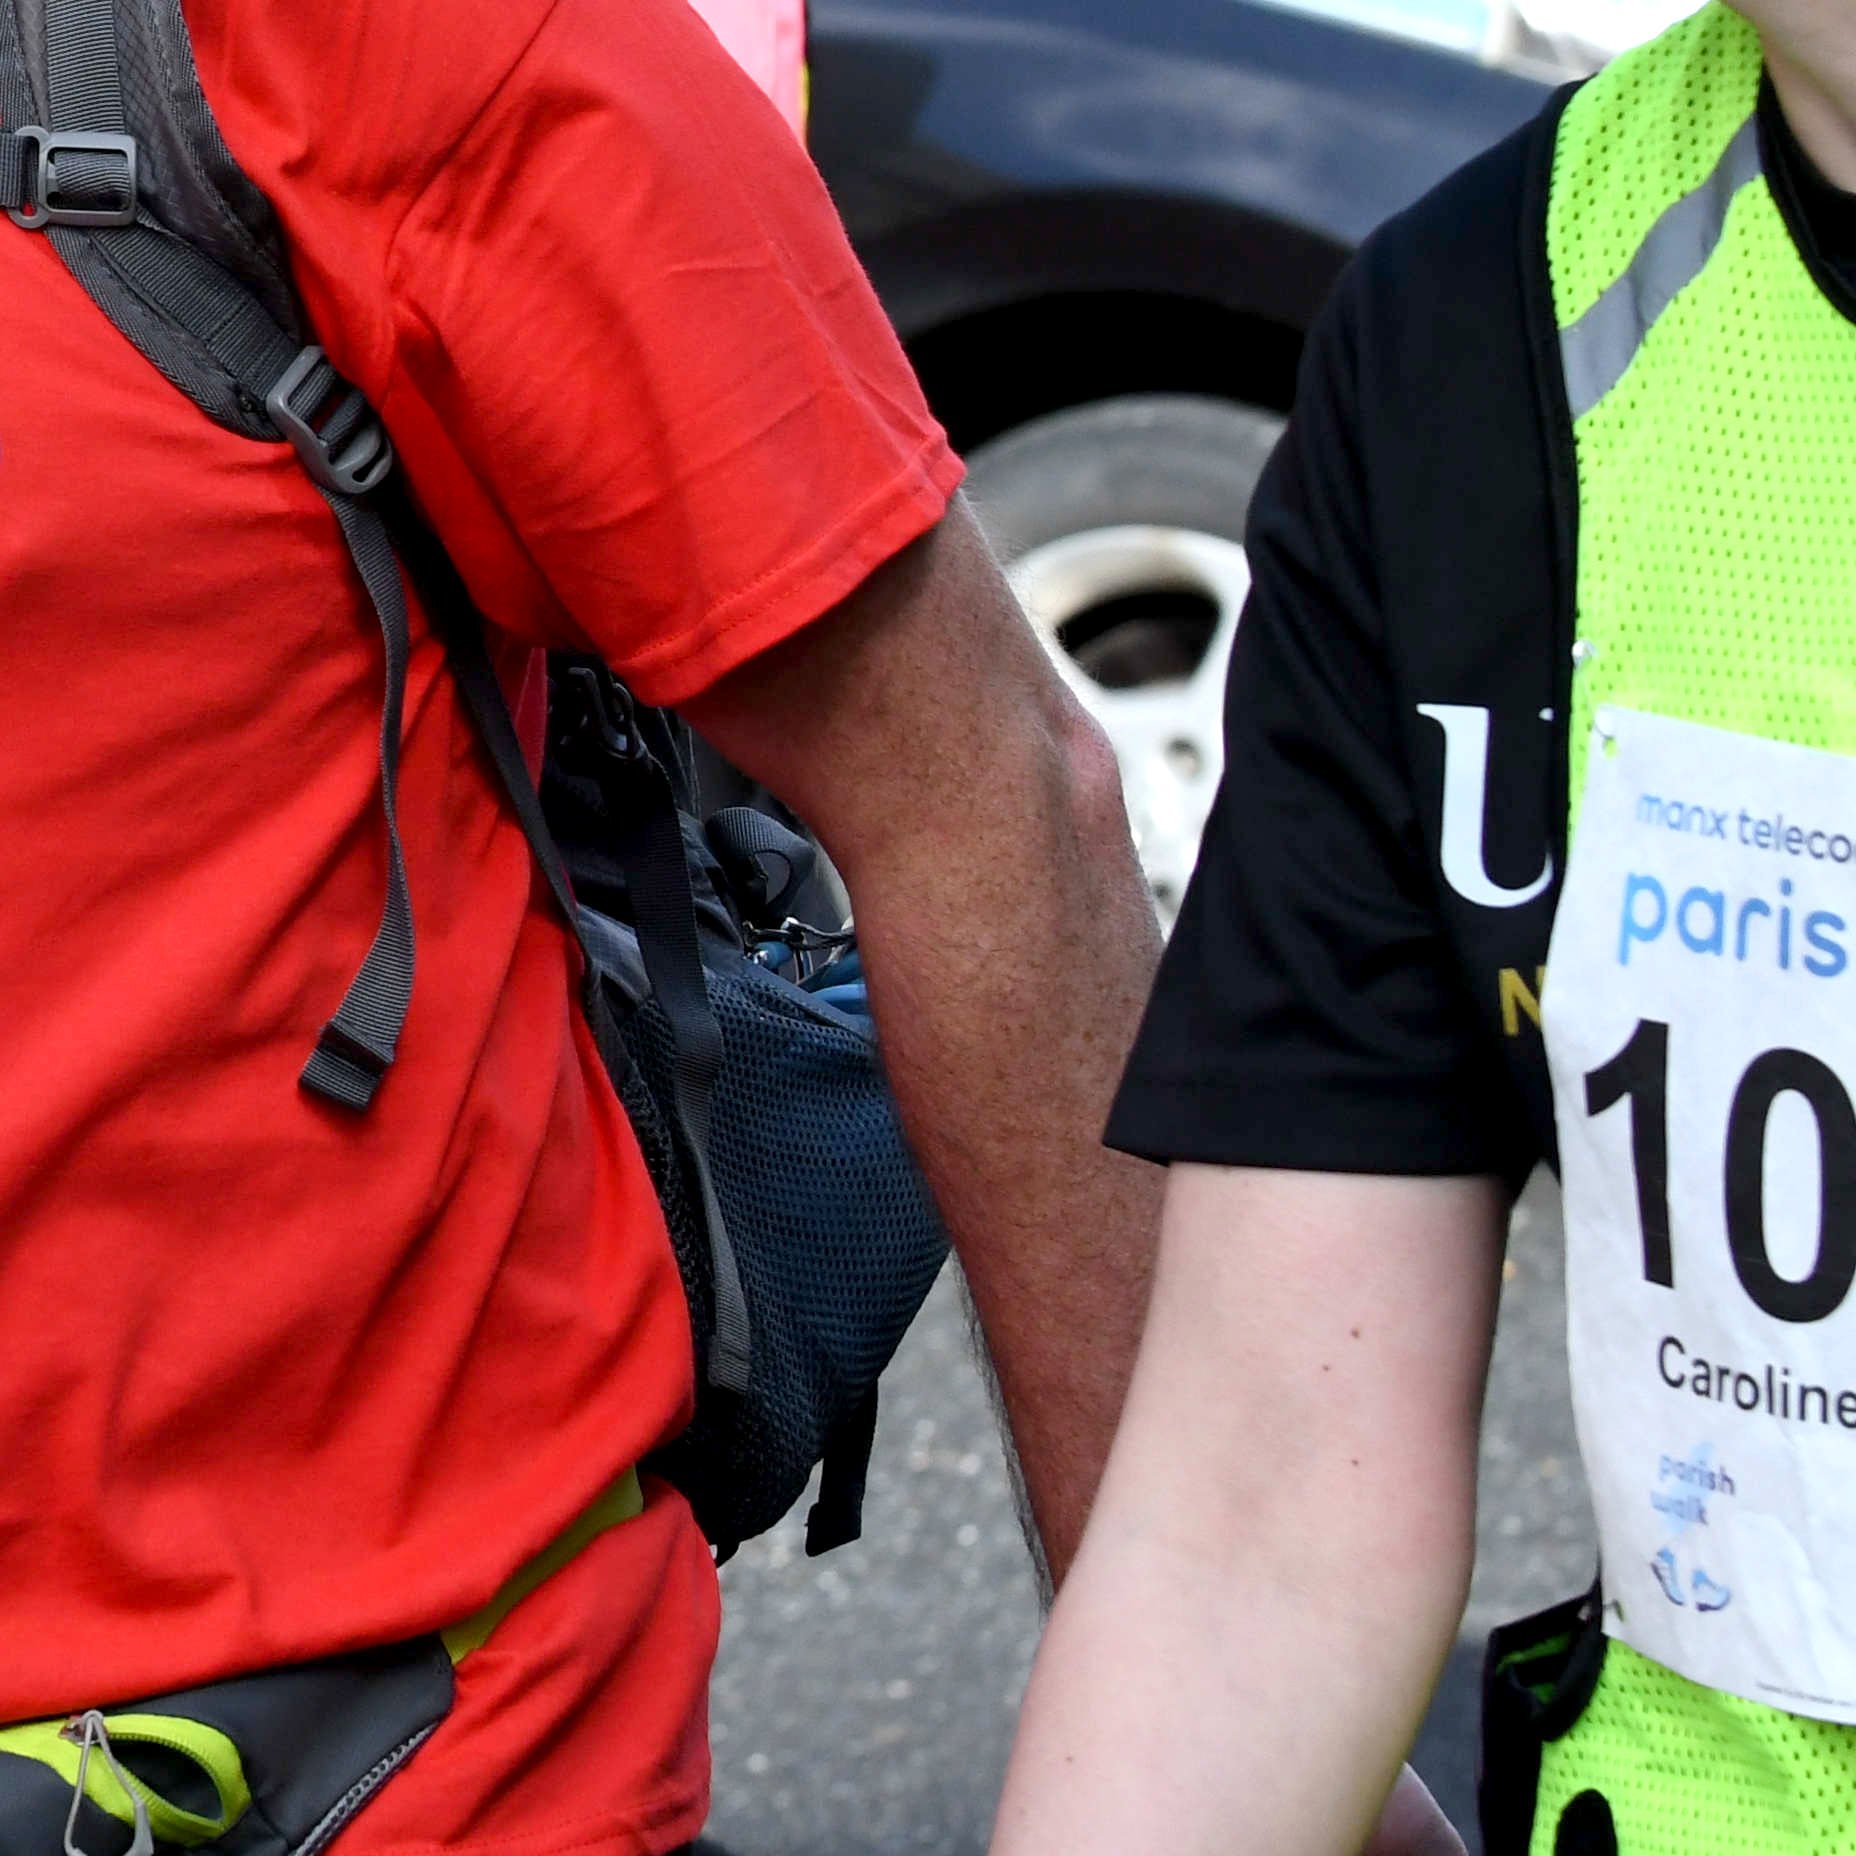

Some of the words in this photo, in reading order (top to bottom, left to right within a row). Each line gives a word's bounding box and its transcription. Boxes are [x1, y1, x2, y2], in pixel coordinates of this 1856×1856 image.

[1638, 793, 1728, 840] manx
[1737, 808, 1856, 864] teleco
[1617, 871, 1848, 978] paris
[1583, 1017, 1856, 1326] 10
[1658, 1335, 1856, 1429] Caroline
